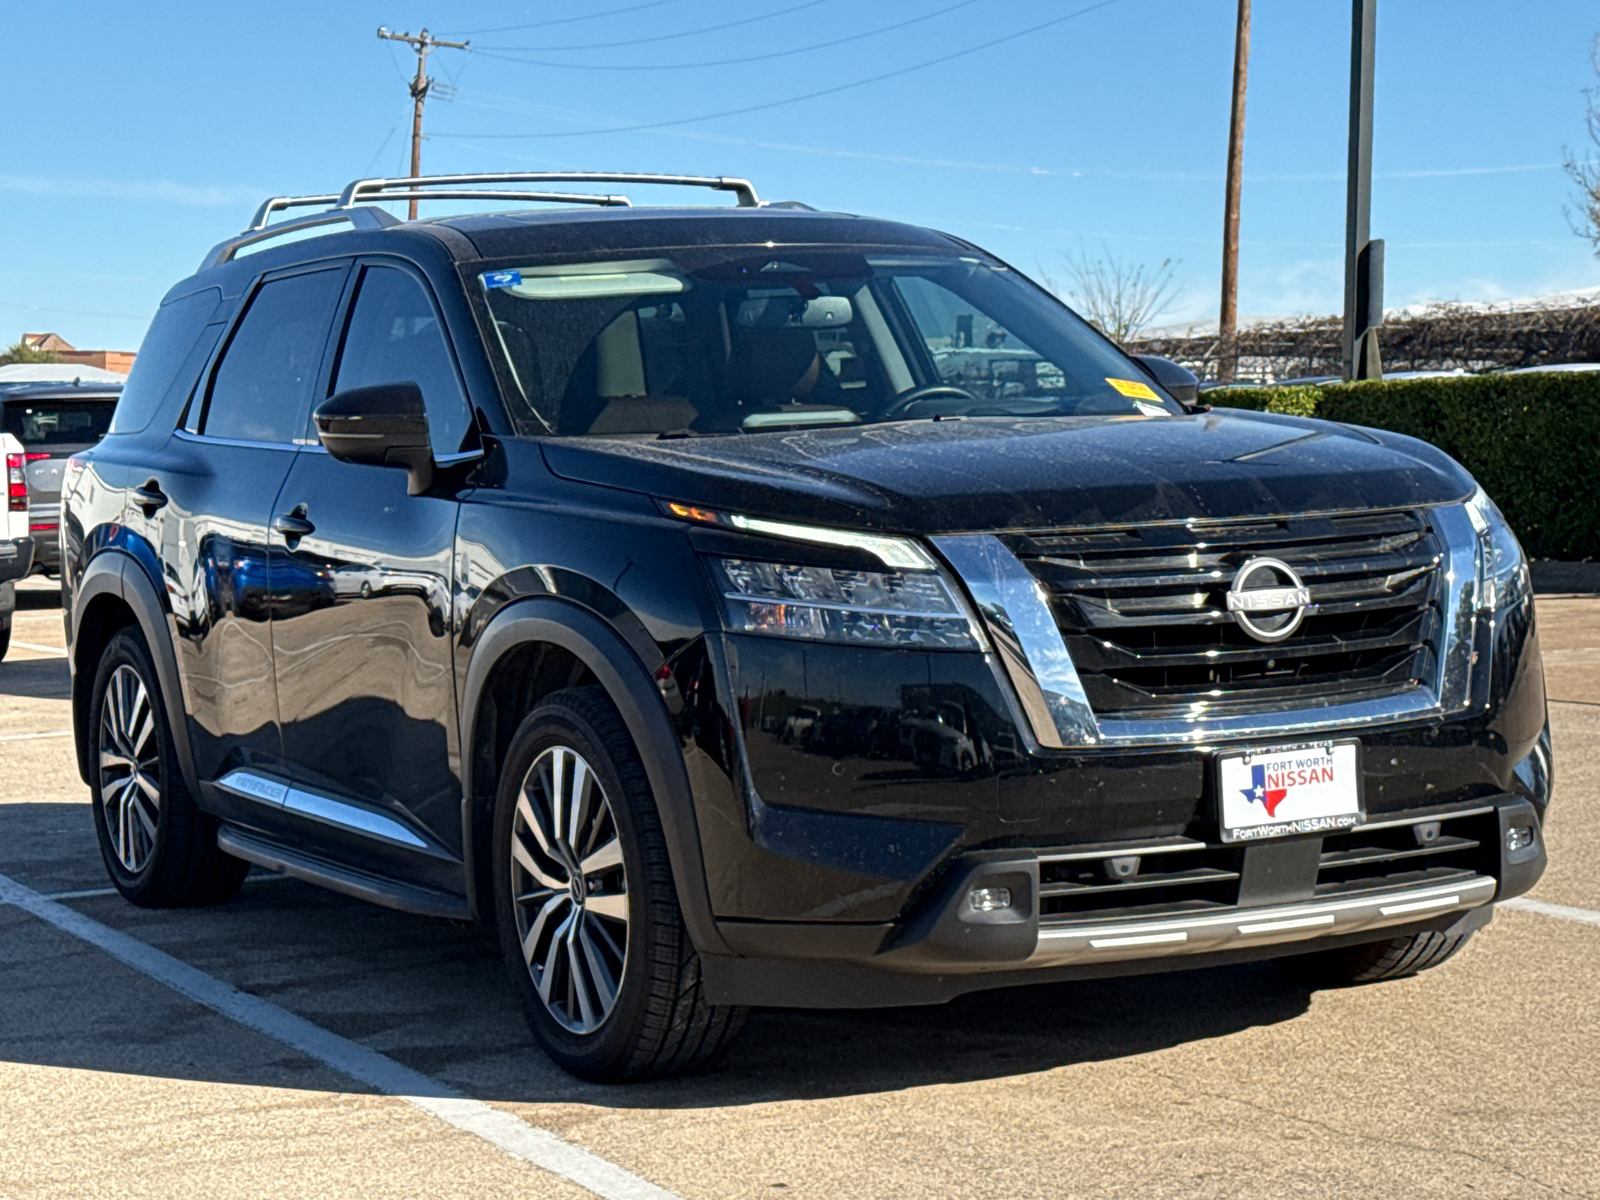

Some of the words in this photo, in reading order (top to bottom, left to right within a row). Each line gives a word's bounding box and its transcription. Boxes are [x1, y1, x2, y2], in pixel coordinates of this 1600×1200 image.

[1229, 590, 1310, 609] NISSAN
[1266, 761, 1293, 772] FORT
[1296, 757, 1333, 769] WORTH
[1267, 766, 1333, 789] NISSAN
